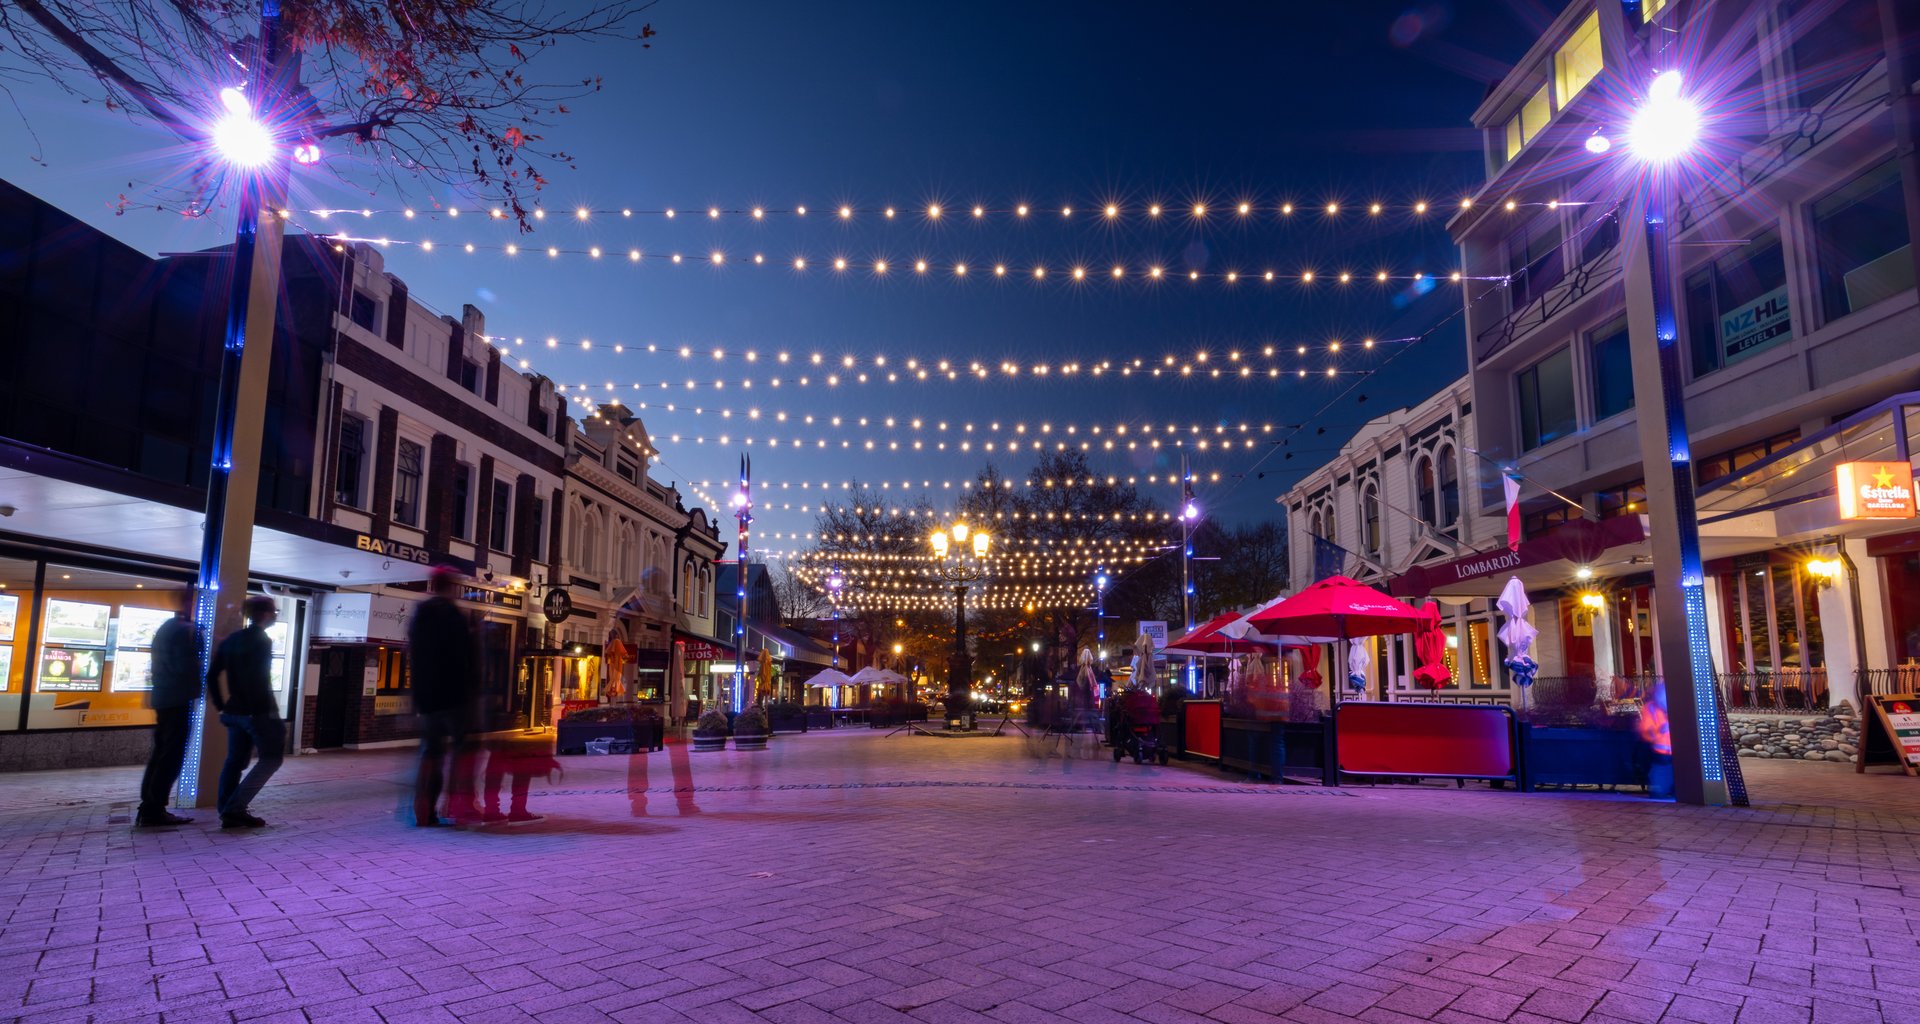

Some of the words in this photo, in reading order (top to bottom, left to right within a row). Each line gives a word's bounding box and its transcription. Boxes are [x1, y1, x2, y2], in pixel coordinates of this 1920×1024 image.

[1724, 298, 1788, 337] NZHL
[1738, 331, 1769, 350] LEVEL
[1770, 326, 1777, 336] 1
[1861, 485, 1911, 499] Estrella
[356, 534, 430, 564] BAYLEYS
[1455, 551, 1521, 578] LOMBARDI'S
[683, 650, 713, 659] RTOIS
